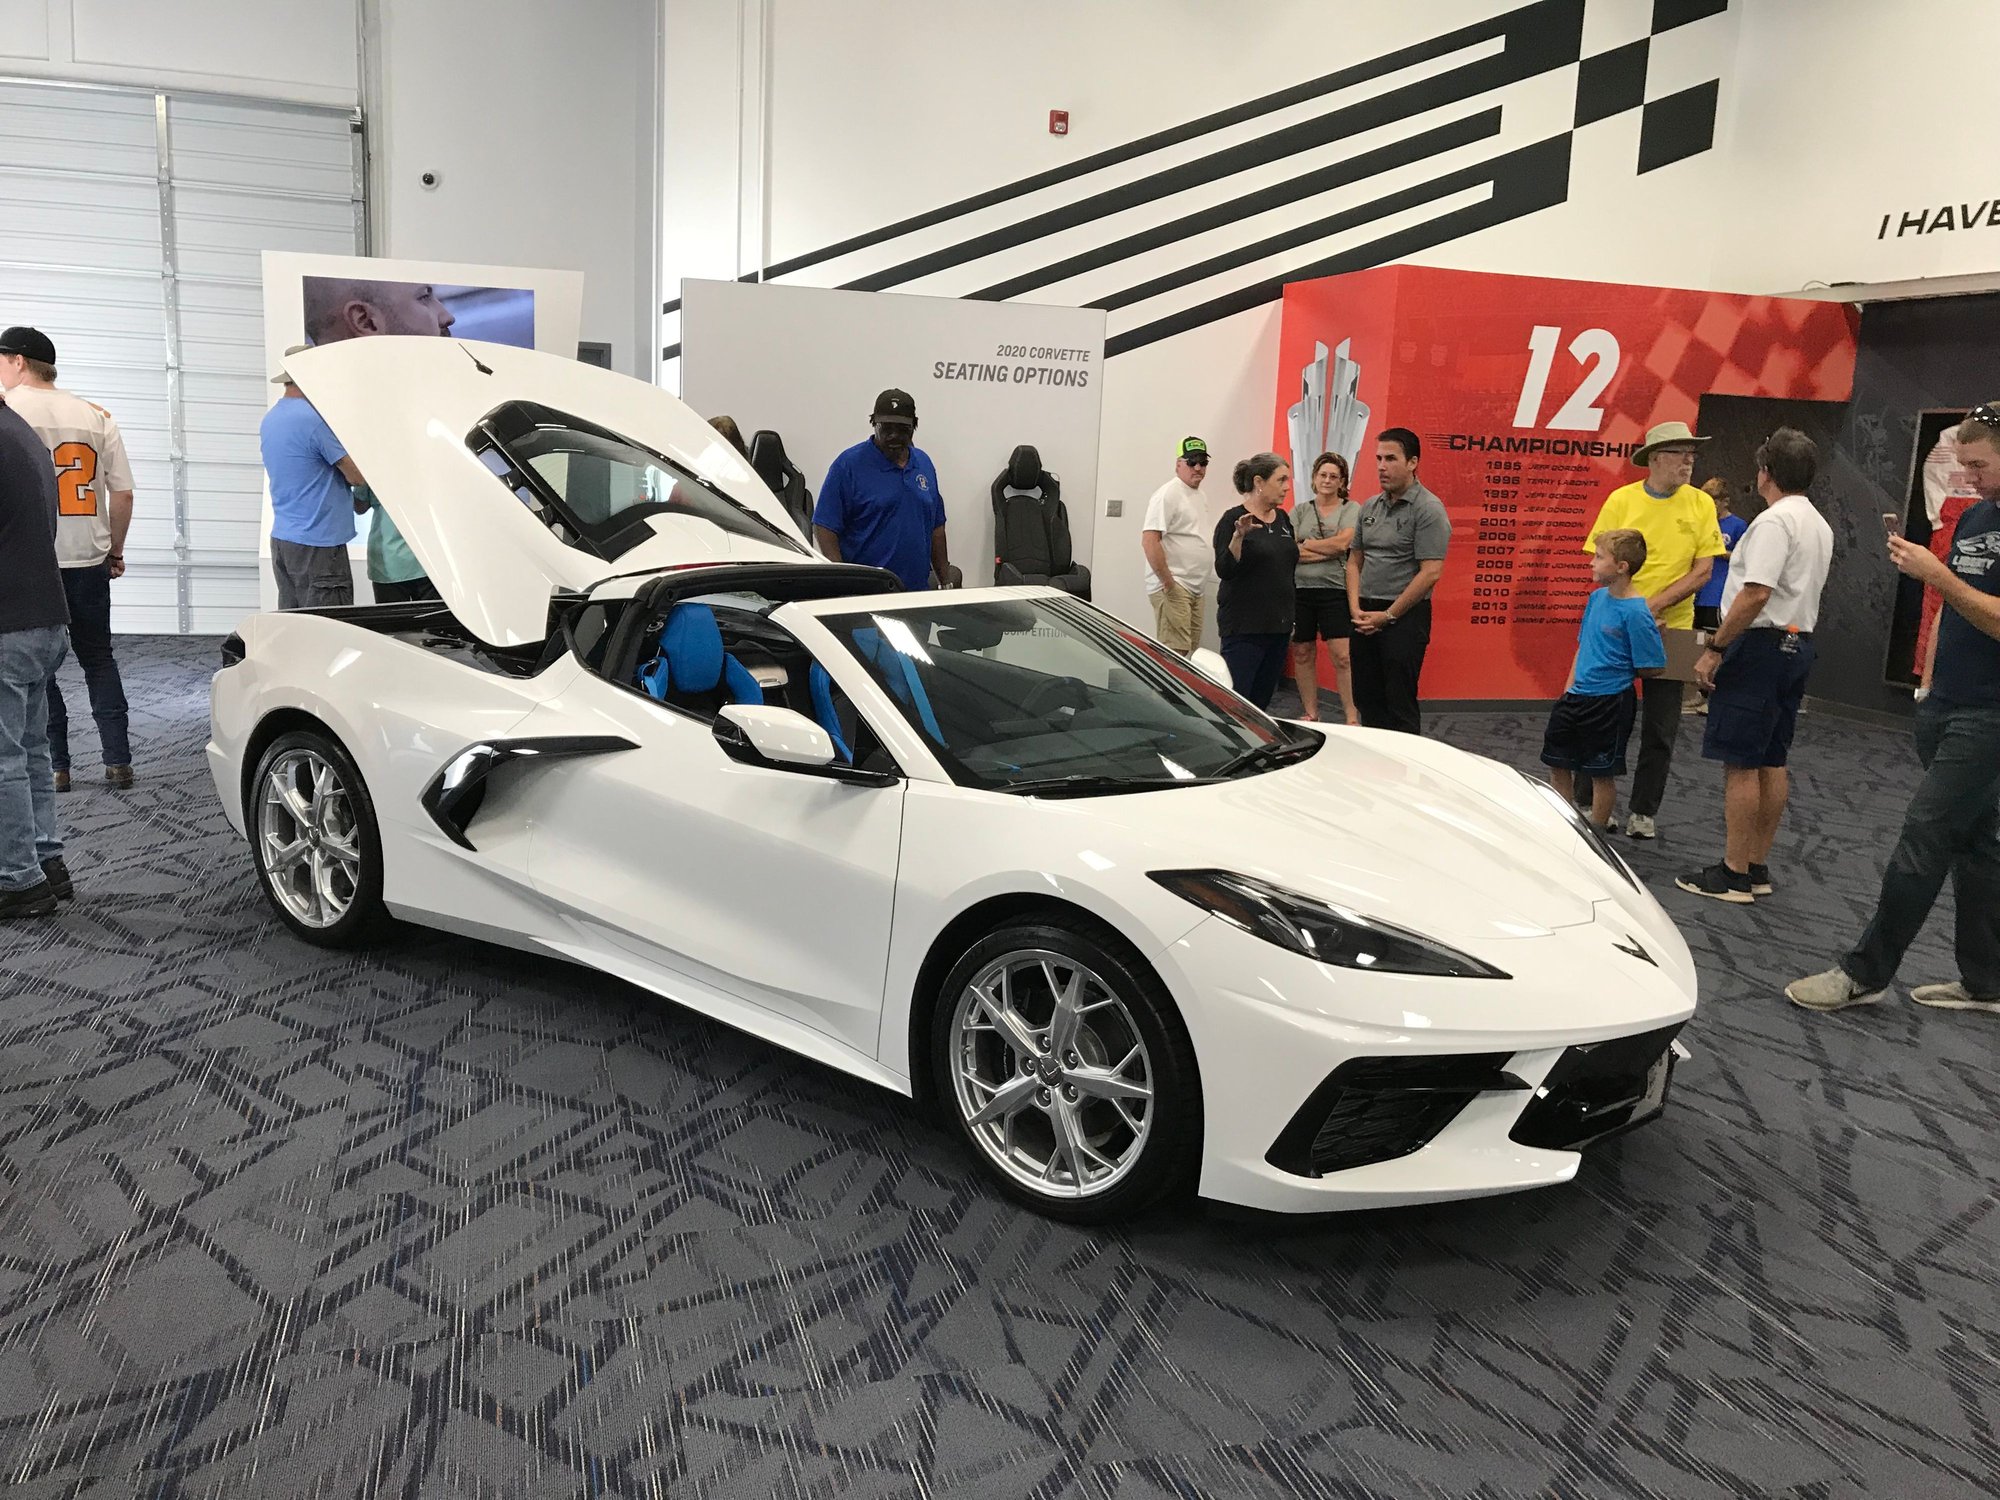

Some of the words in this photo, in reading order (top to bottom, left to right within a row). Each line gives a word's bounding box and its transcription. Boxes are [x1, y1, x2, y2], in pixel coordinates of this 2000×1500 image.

[1878, 214, 1890, 240] I
[997, 344, 1026, 358] 2020
[1029, 346, 1091, 362] CORVETTE
[933, 361, 1009, 383] SEATING
[1013, 366, 1089, 388] OPTIONS
[1512, 325, 1620, 431] 12
[1486, 461, 1522, 471] 1995
[1484, 475, 1520, 485] 1996
[1483, 489, 1518, 499] 1997
[1482, 503, 1517, 513] 1998
[1480, 518, 1516, 527] 2001
[1478, 532, 1516, 541] 2006
[1477, 546, 1515, 555] 2007
[1476, 560, 1513, 569] 2008
[1475, 574, 1512, 583] 2009
[1473, 588, 1509, 597] 2010
[1471, 602, 1507, 611] 2013
[1470, 616, 1506, 625] 2016
